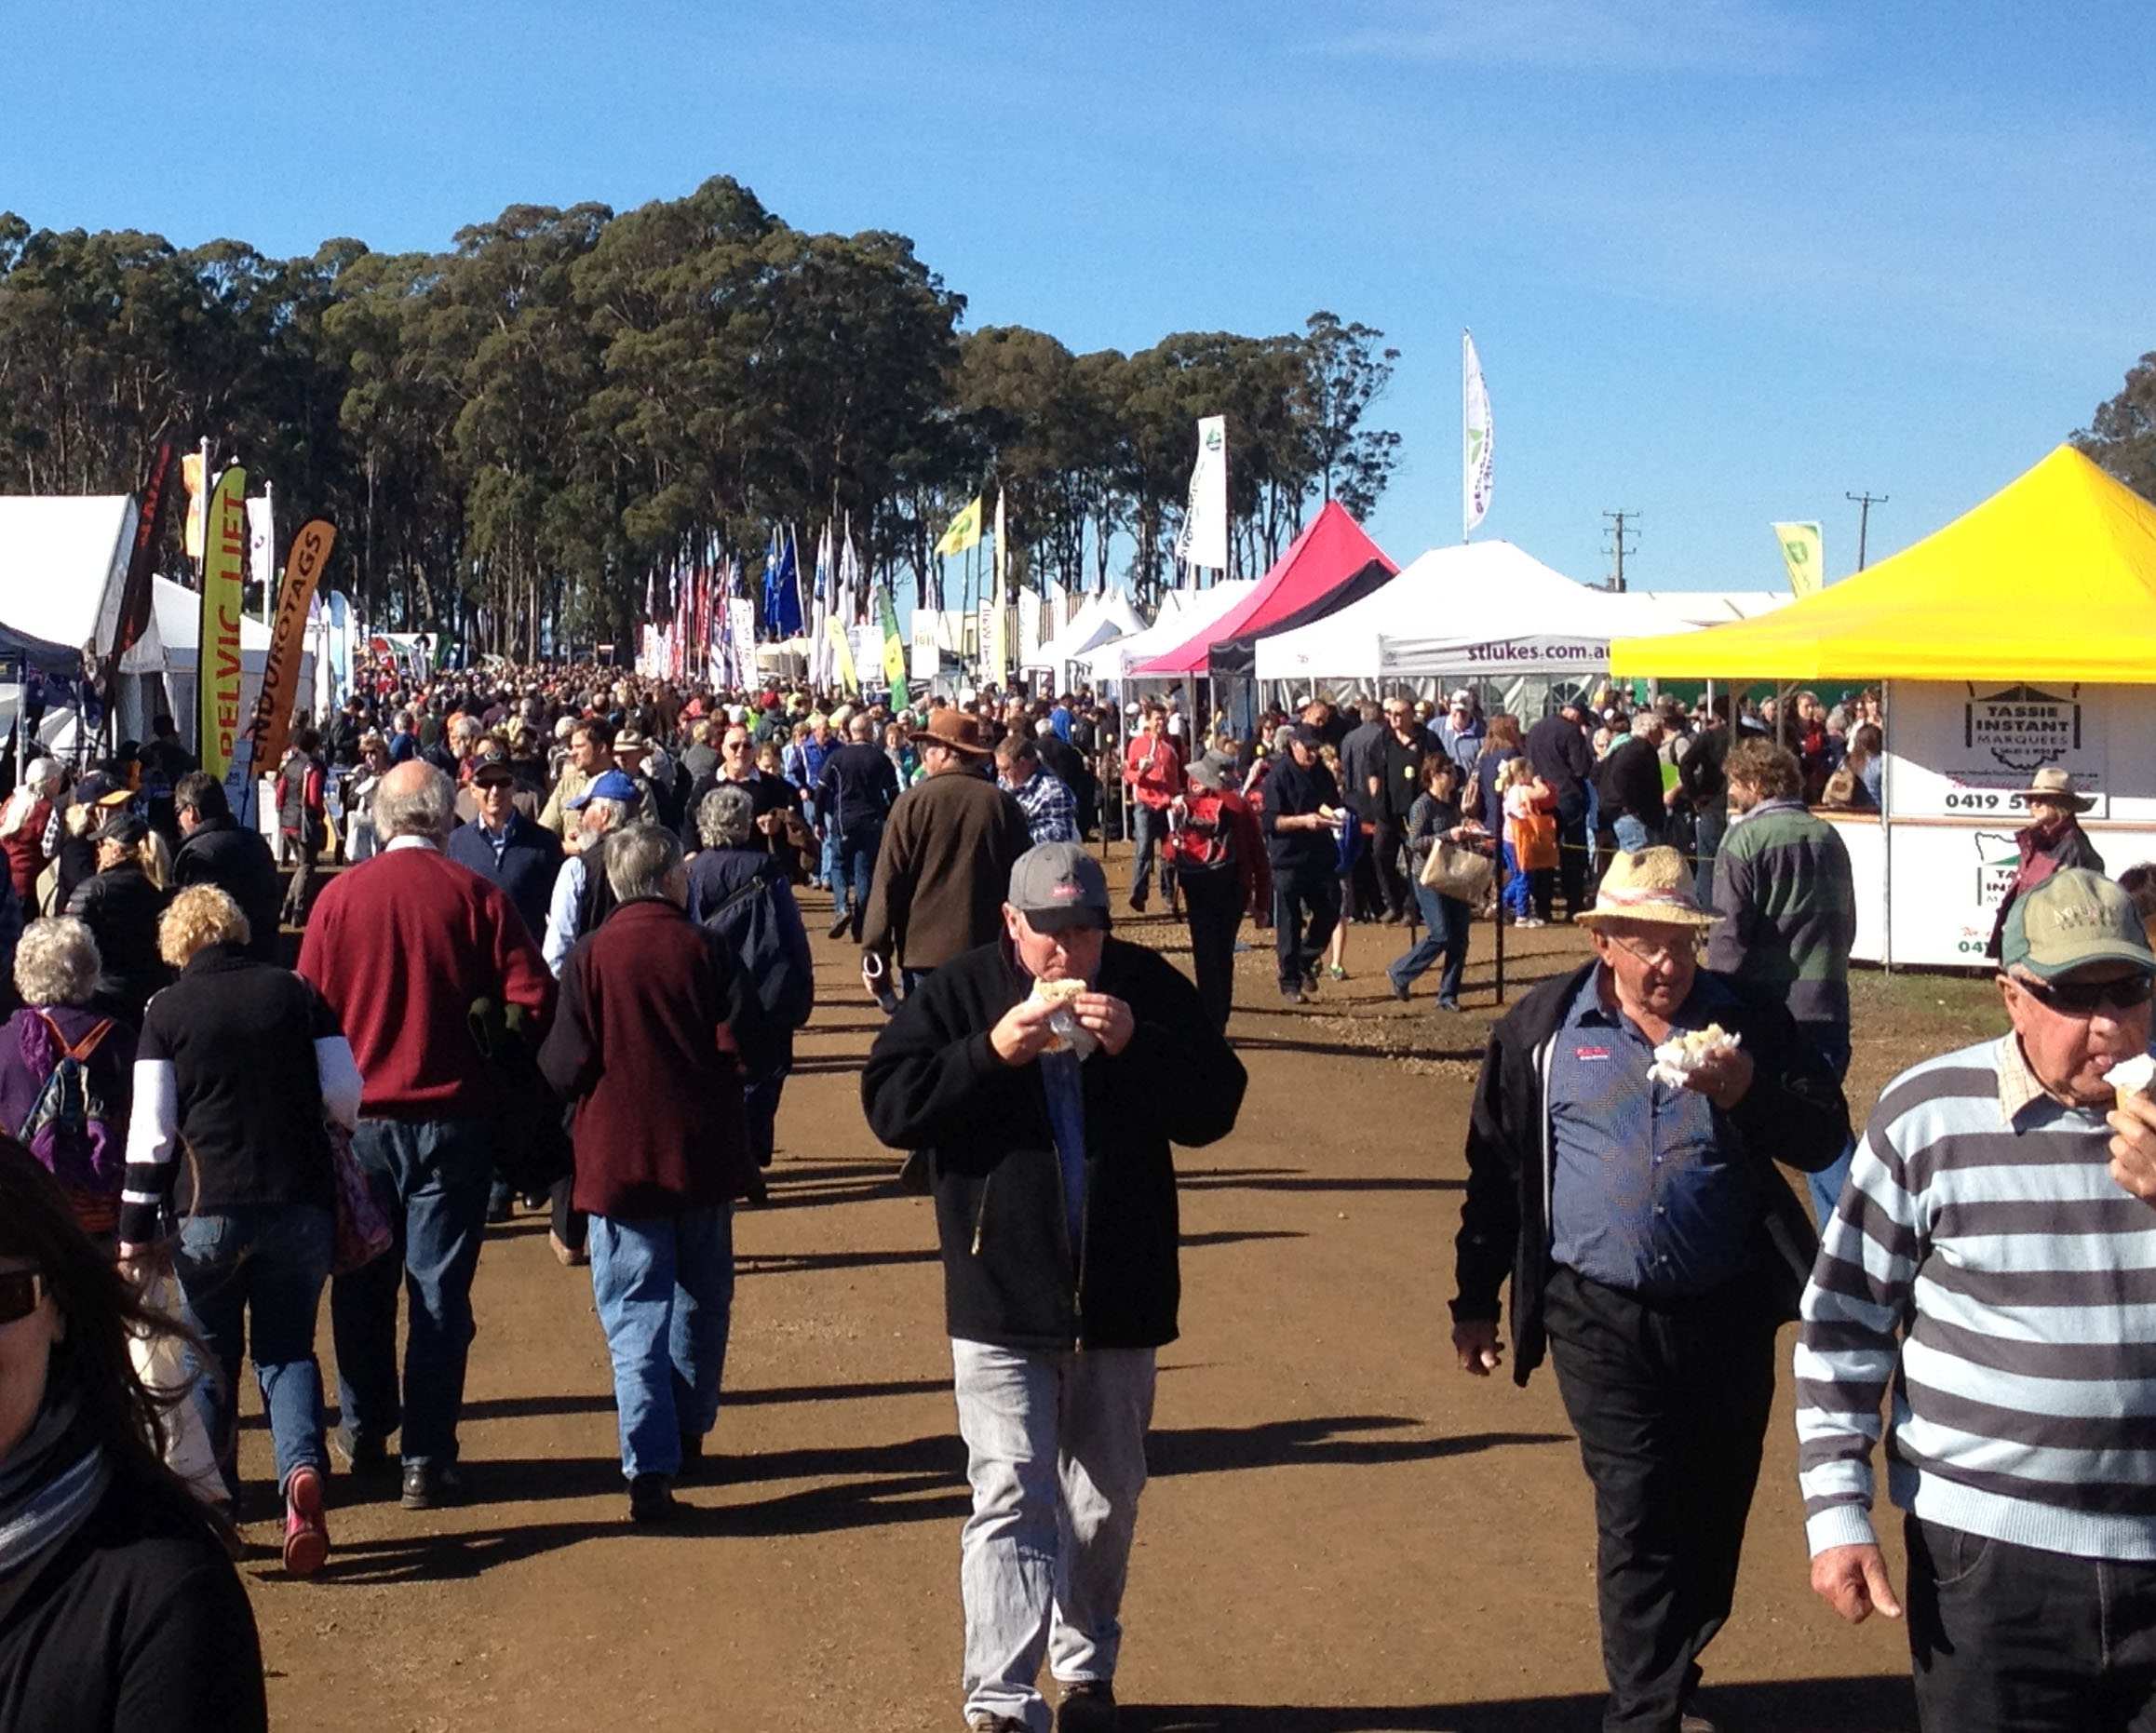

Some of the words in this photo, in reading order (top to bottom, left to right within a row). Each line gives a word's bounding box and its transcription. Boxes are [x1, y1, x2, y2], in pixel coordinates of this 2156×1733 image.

[1467, 640, 1610, 661] stlukes.com.a
[216, 605, 240, 758] PELVIC
[1987, 705, 2058, 717] TASSIE
[1975, 720, 2069, 732] INSTANT
[1976, 734, 2068, 745] MARQUEES
[1945, 793, 2000, 810] 0419
